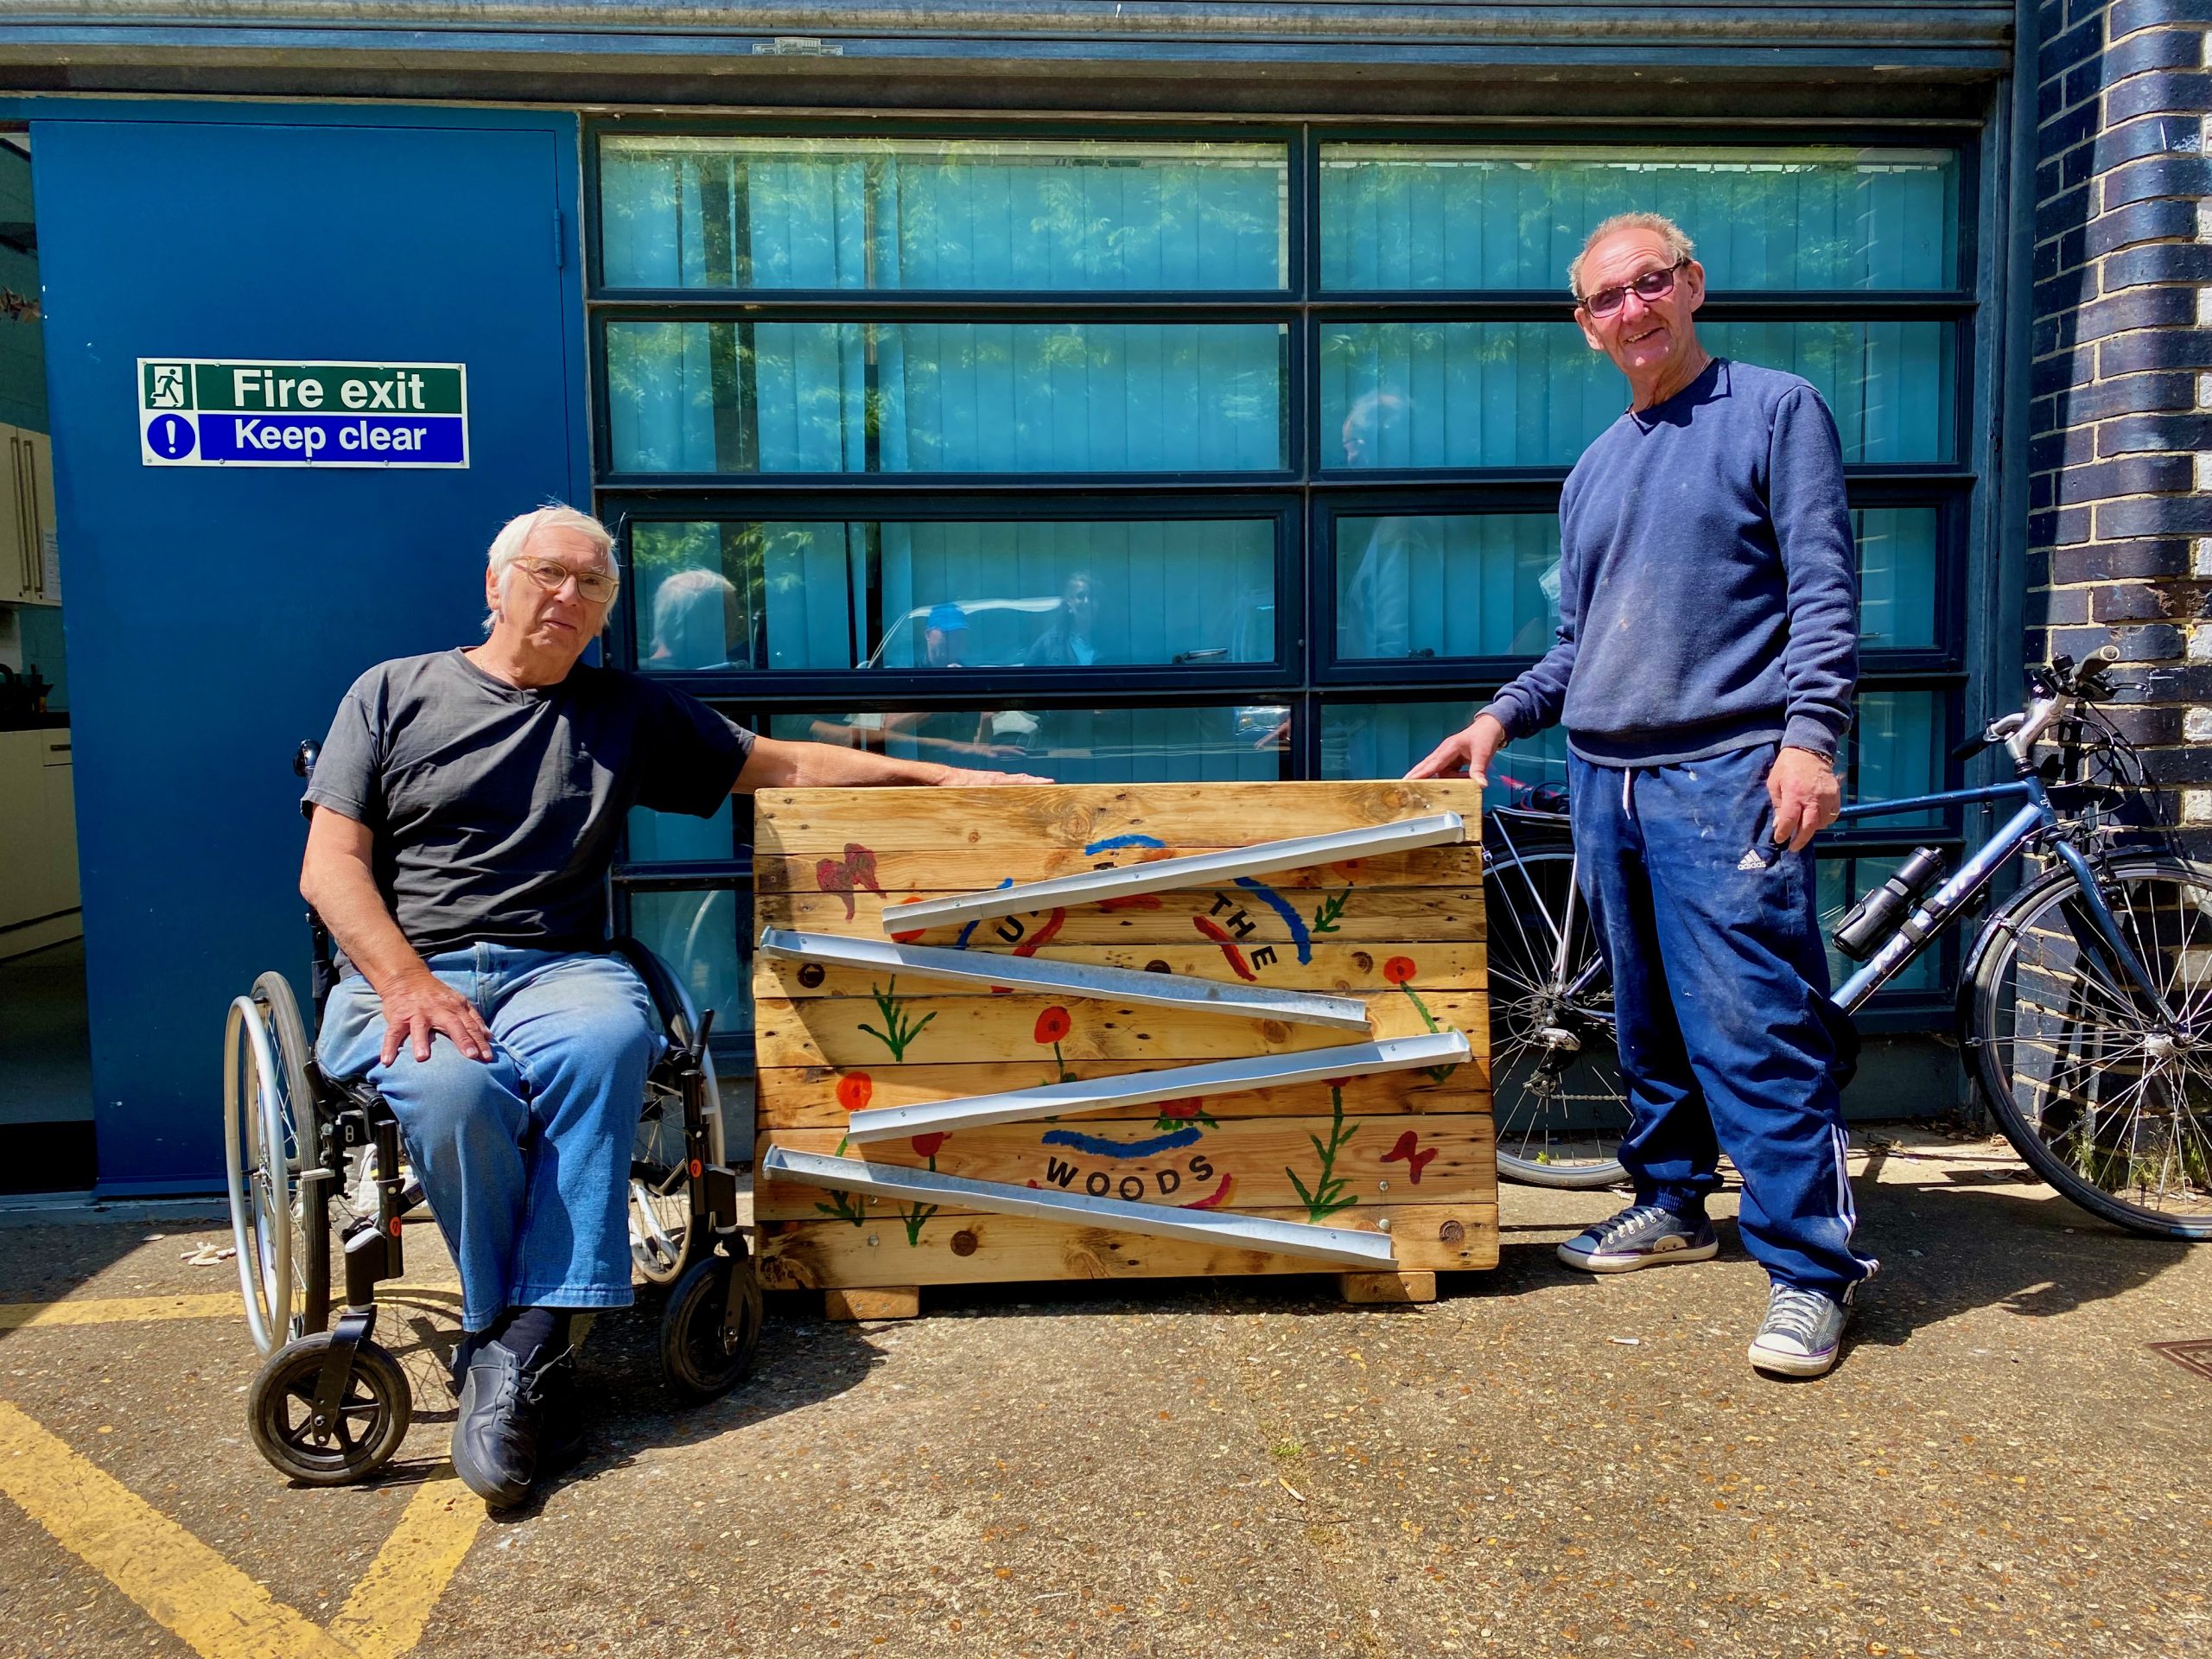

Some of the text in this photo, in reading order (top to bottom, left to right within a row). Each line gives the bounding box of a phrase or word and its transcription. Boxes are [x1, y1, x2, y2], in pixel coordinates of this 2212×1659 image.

[232, 369, 426, 410] Fire exit
[234, 418, 427, 457] Keep clear
[1737, 860, 1767, 871] adidas
[1209, 891, 1278, 970] THE
[1046, 1155, 1214, 1201] WOODS
